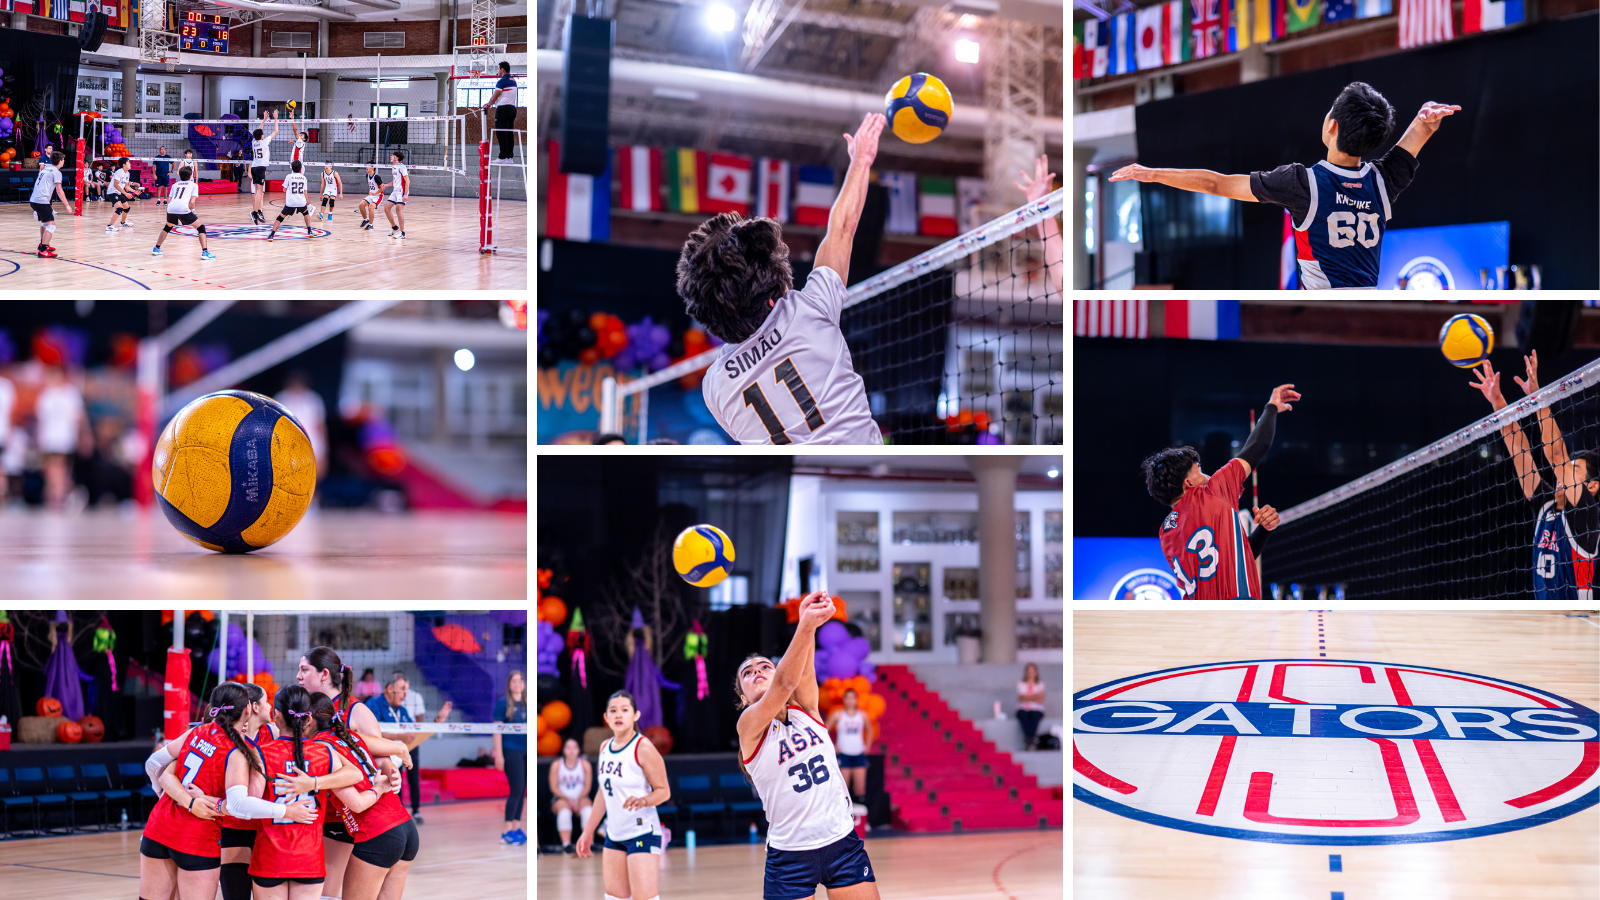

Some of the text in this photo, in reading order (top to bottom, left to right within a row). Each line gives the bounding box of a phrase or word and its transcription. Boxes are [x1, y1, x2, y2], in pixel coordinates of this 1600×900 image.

[182, 26, 228, 40] 23 18
[253, 148, 264, 159] 15
[173, 187, 186, 200] 11
[291, 181, 305, 195] 22
[1327, 211, 1381, 249] 60
[724, 328, 782, 379] SIMÃO
[741, 356, 827, 445] 11
[245, 438, 259, 503] MIKASA
[1073, 701, 1598, 741] GATORS
[778, 725, 825, 766] ASA
[181, 750, 206, 791] 7
[600, 760, 623, 778] ASA
[604, 778, 614, 797] 4
[787, 753, 831, 794] 36
